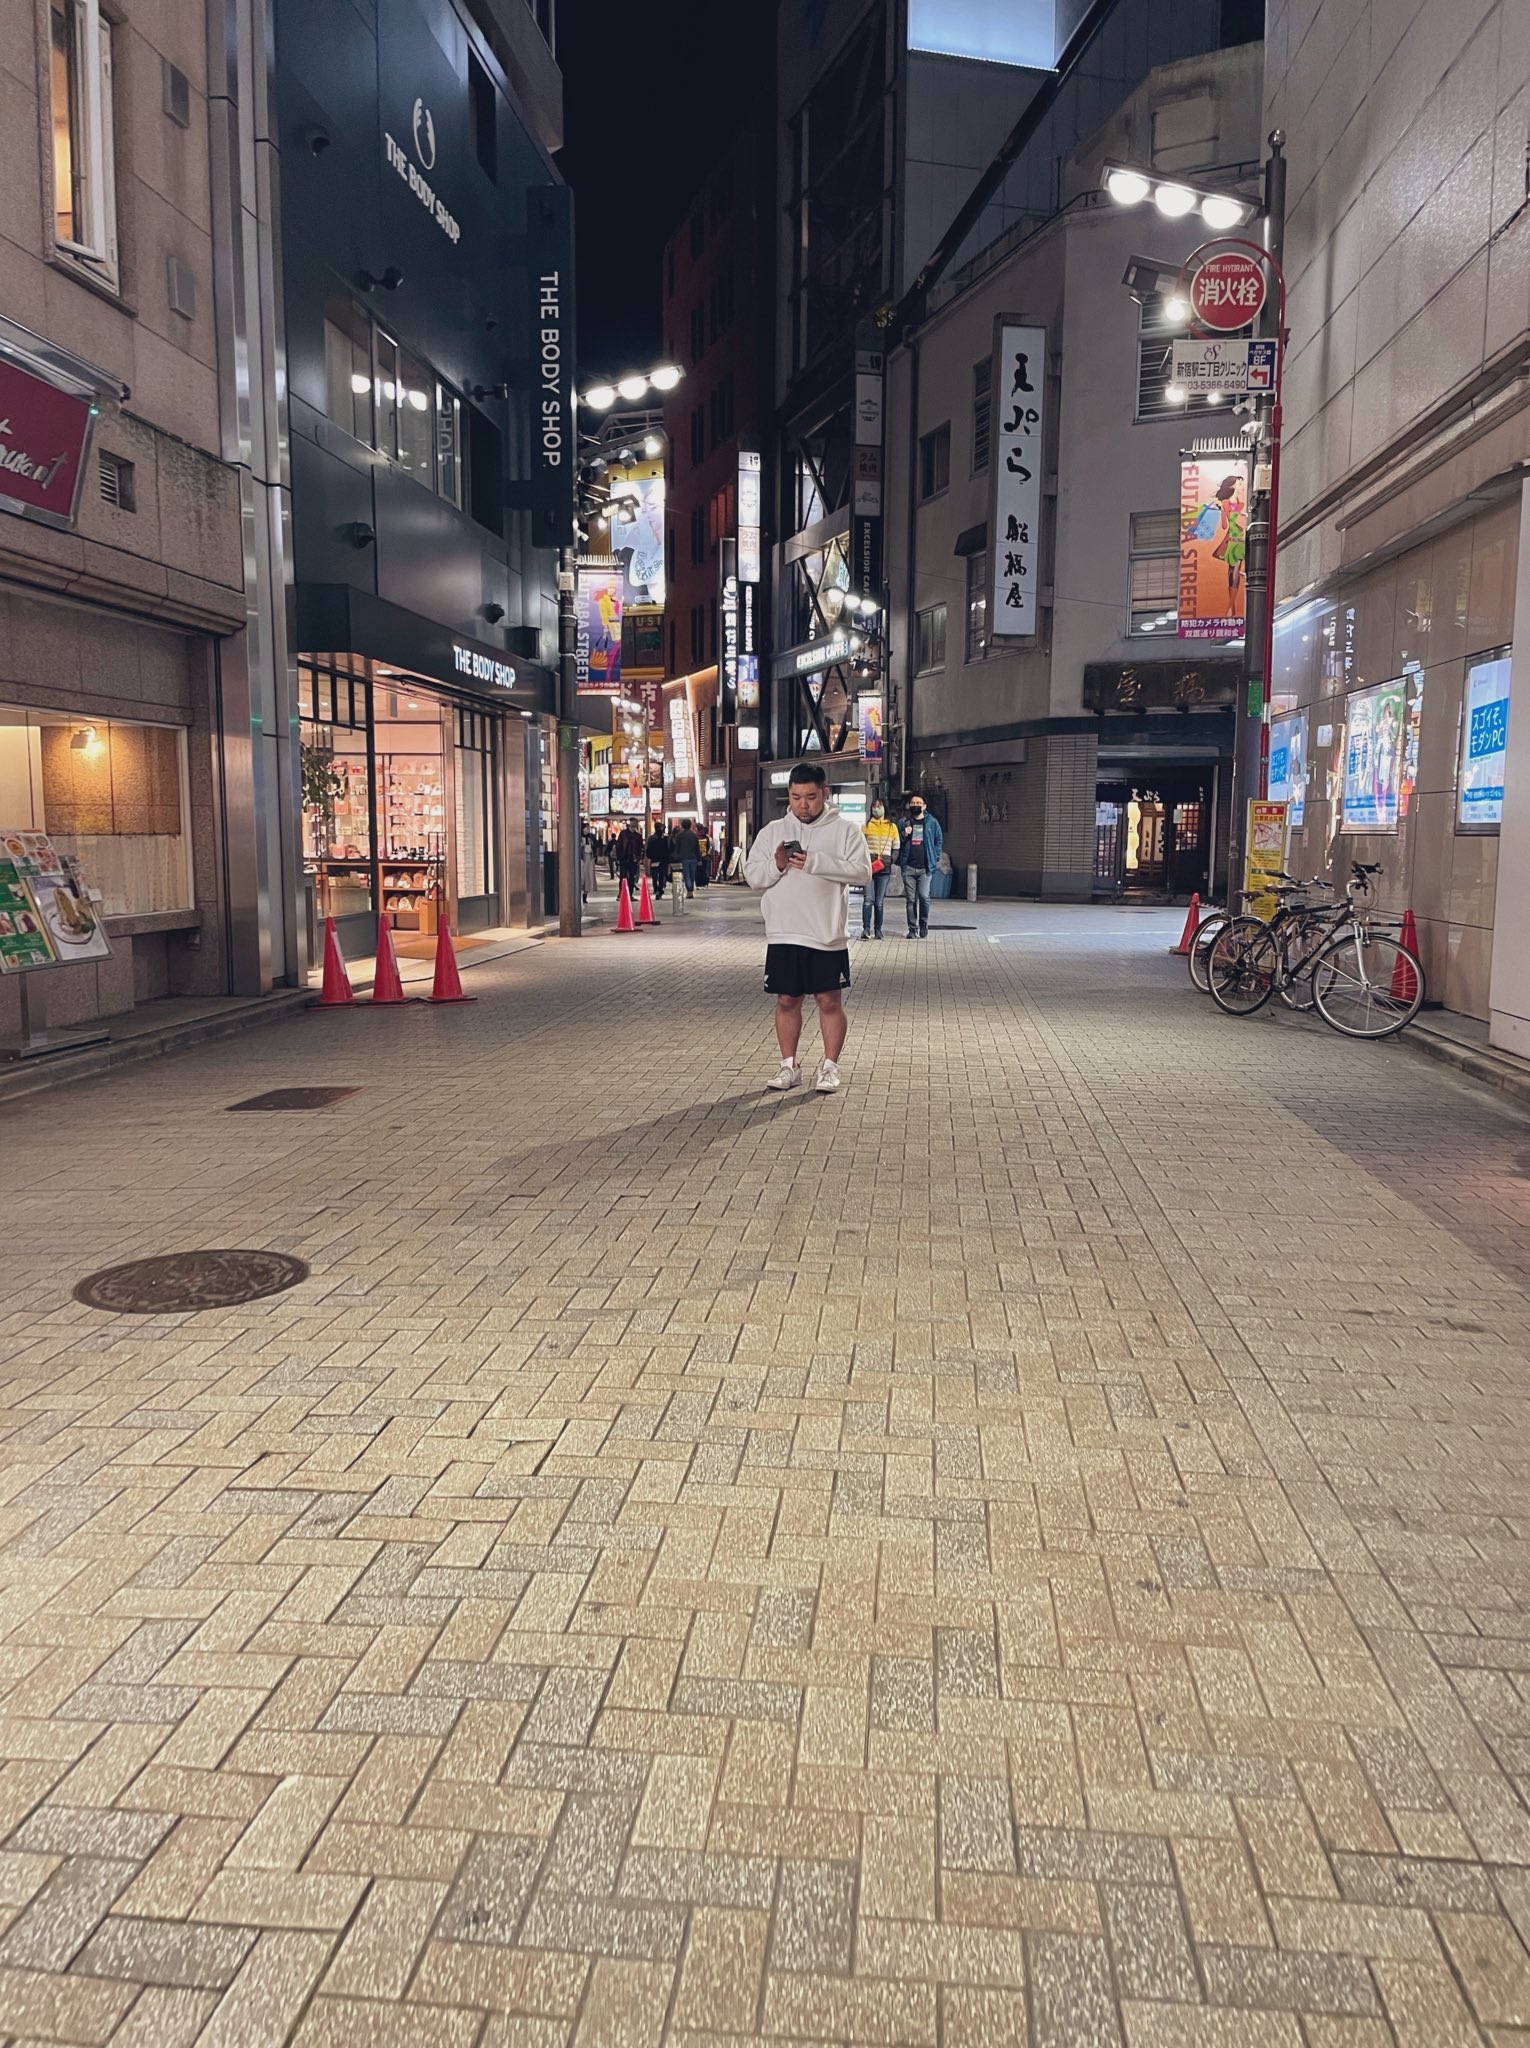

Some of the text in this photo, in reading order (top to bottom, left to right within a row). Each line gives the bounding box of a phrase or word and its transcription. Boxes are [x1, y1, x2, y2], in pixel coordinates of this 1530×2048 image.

[384, 132, 461, 244] THE BODY SHOP
[1205, 264, 1254, 273] FIRE HYDRANT
[1198, 277, 1260, 306] 消火栓
[540, 271, 562, 466] THE BODY SHOP
[1177, 361, 1247, 378] 新宿駅三丁目クリニック
[1253, 355, 1267, 365] 8F
[863, 522, 871, 573] EXCELSIOR
[1179, 464, 1199, 618] FUTABA STREET
[1181, 618, 1244, 628] 防犯カメラ作動中
[453, 645, 516, 689] THE BODY SHOP
[576, 631, 590, 682] STREET
[1471, 727, 1505, 753] モダンPC
